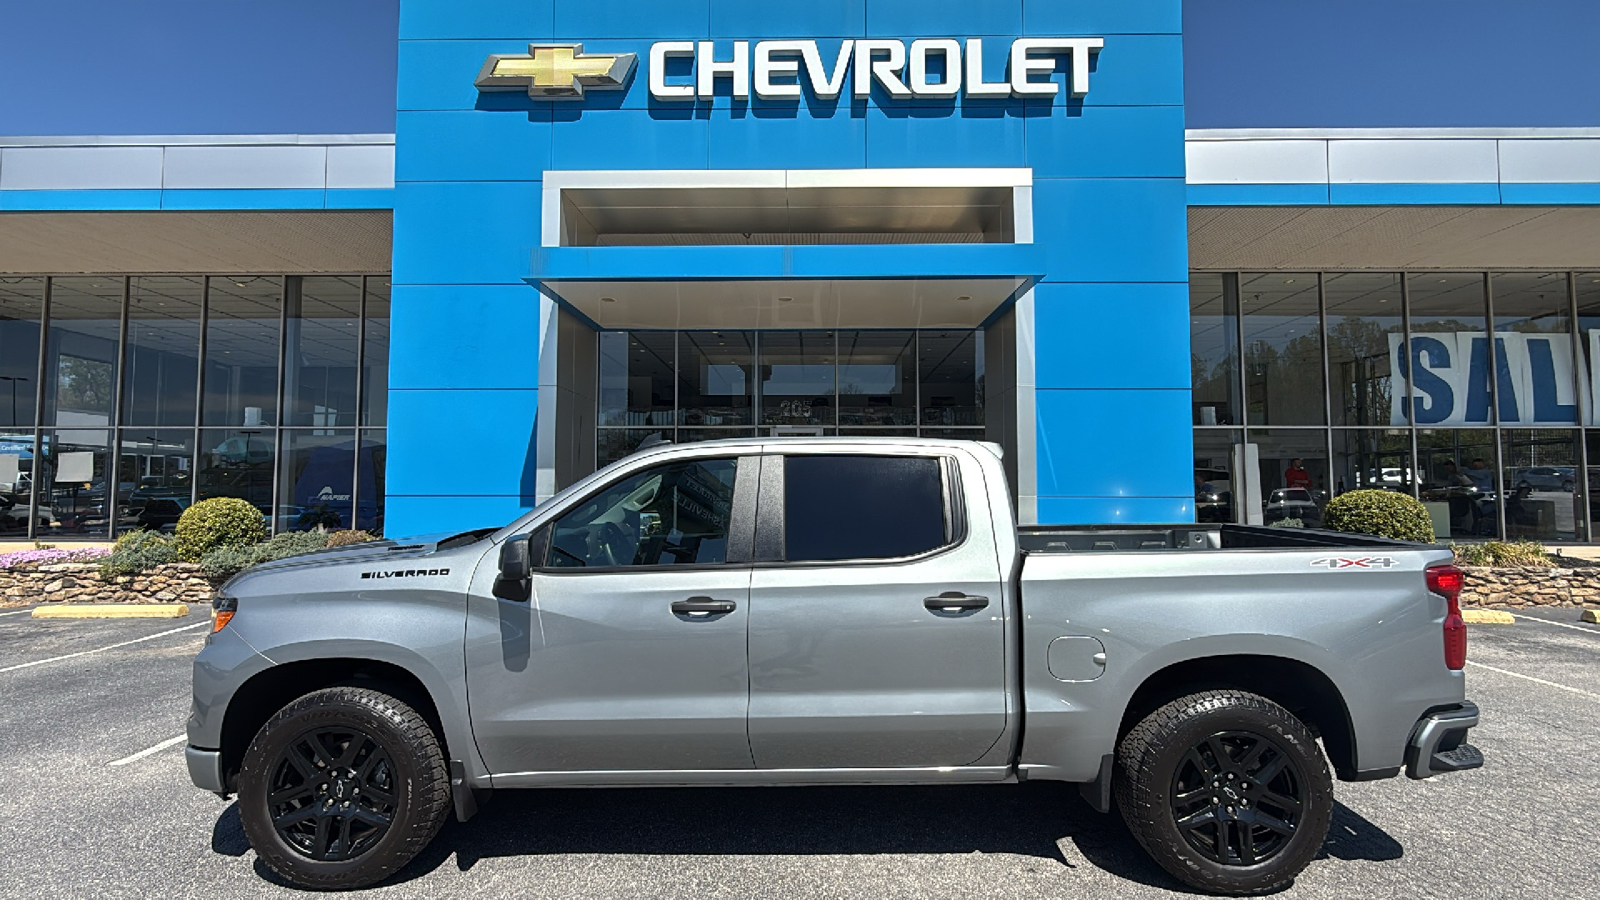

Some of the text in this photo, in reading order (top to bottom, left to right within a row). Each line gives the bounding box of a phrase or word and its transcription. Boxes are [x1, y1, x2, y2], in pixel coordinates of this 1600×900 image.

[649, 38, 1104, 101] CHEVROLET
[1397, 334, 1600, 424] SAL
[780, 399, 812, 418] 205
[360, 568, 450, 580] SILVERADO
